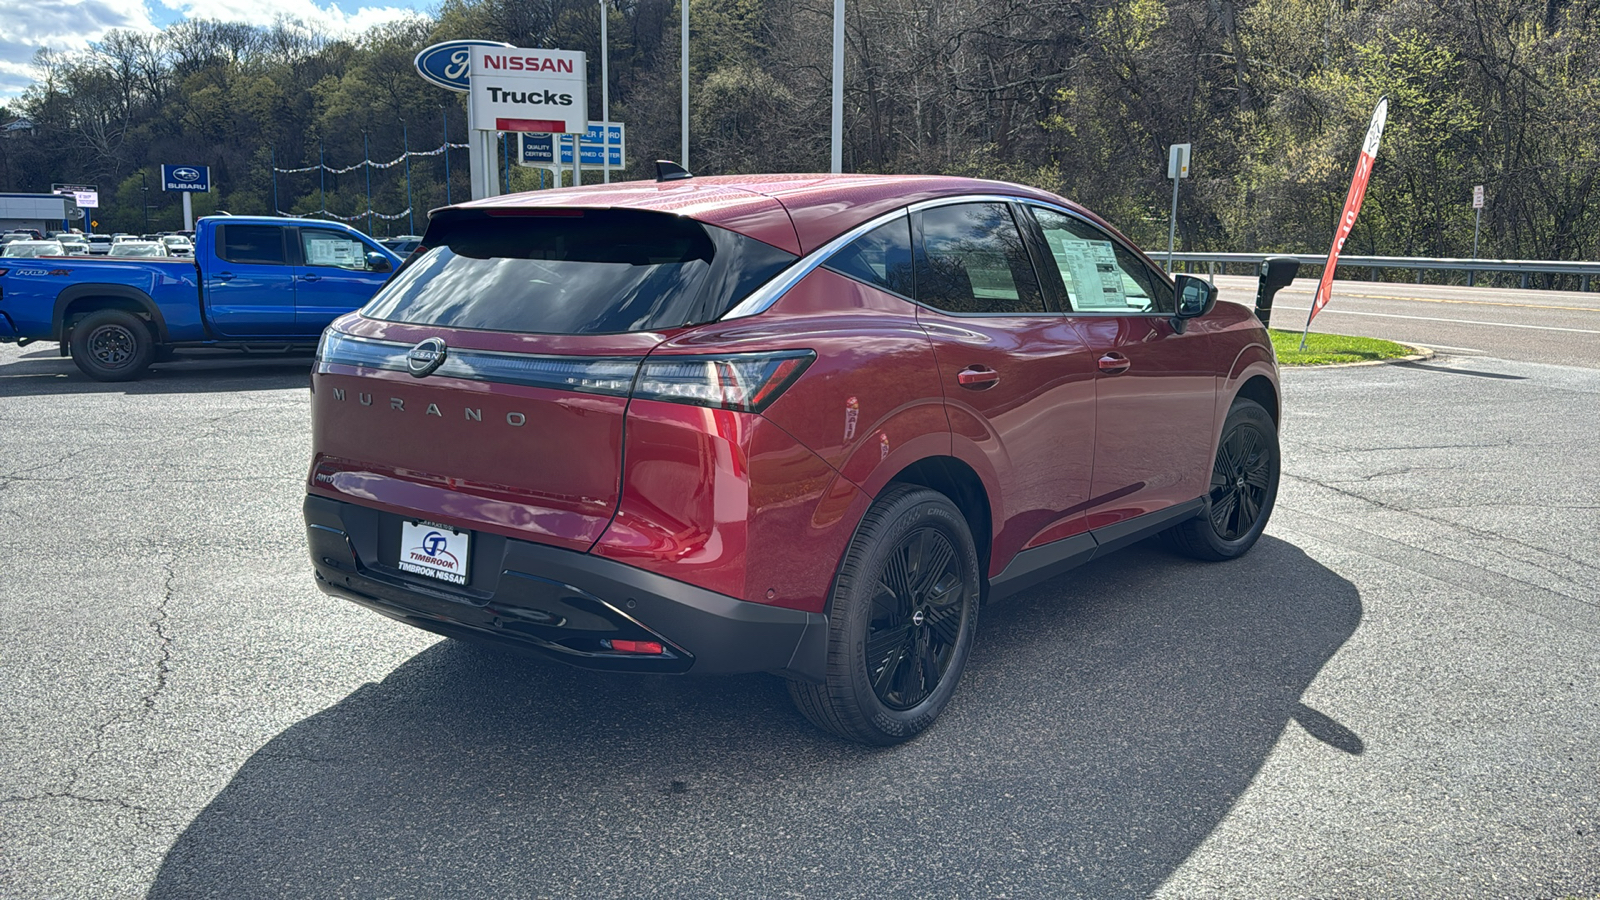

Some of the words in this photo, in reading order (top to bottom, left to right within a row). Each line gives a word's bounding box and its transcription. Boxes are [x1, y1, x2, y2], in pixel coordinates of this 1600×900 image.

[484, 55, 573, 73] NISSAN
[486, 87, 573, 106] Trucks
[599, 131, 620, 139] FRD
[598, 151, 620, 159] CETER
[167, 182, 206, 190] SUBARU
[332, 387, 527, 427] MURANO
[410, 552, 455, 569] TIMBROOK
[398, 561, 436, 578] TIMBROOK
[435, 570, 466, 585] NISSAN
